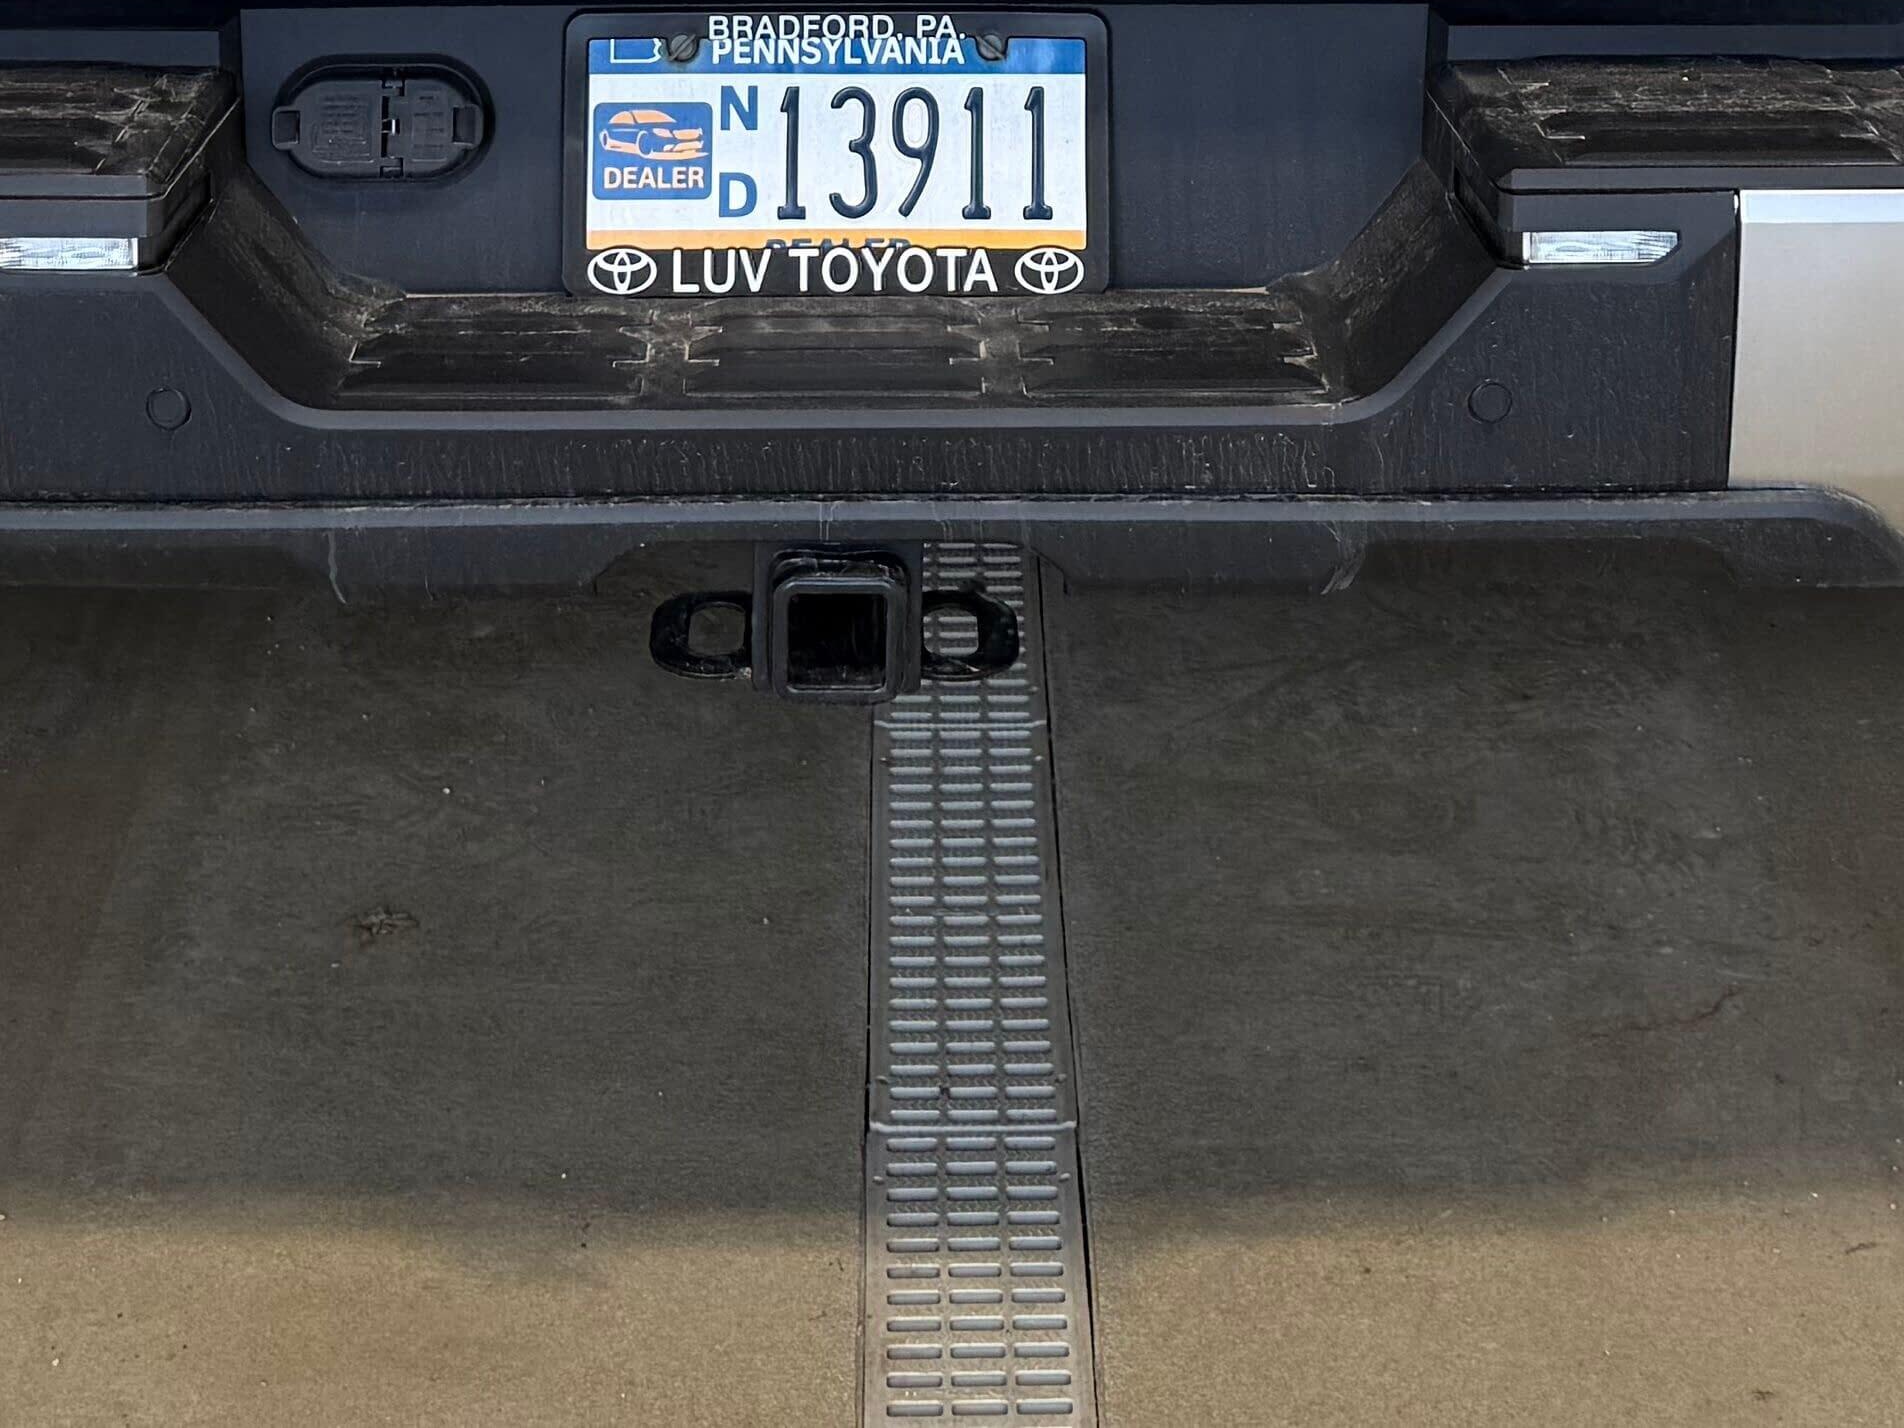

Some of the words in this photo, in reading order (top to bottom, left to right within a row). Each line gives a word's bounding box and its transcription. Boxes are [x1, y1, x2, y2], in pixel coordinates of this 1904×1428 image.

[916, 15, 966, 40] PA.
[711, 37, 965, 65] PENNSYLVANIA
[777, 86, 1054, 220] 13911
[604, 167, 704, 189] DEALER
[672, 248, 772, 292] LUV
[783, 248, 998, 293] TOYOTA
